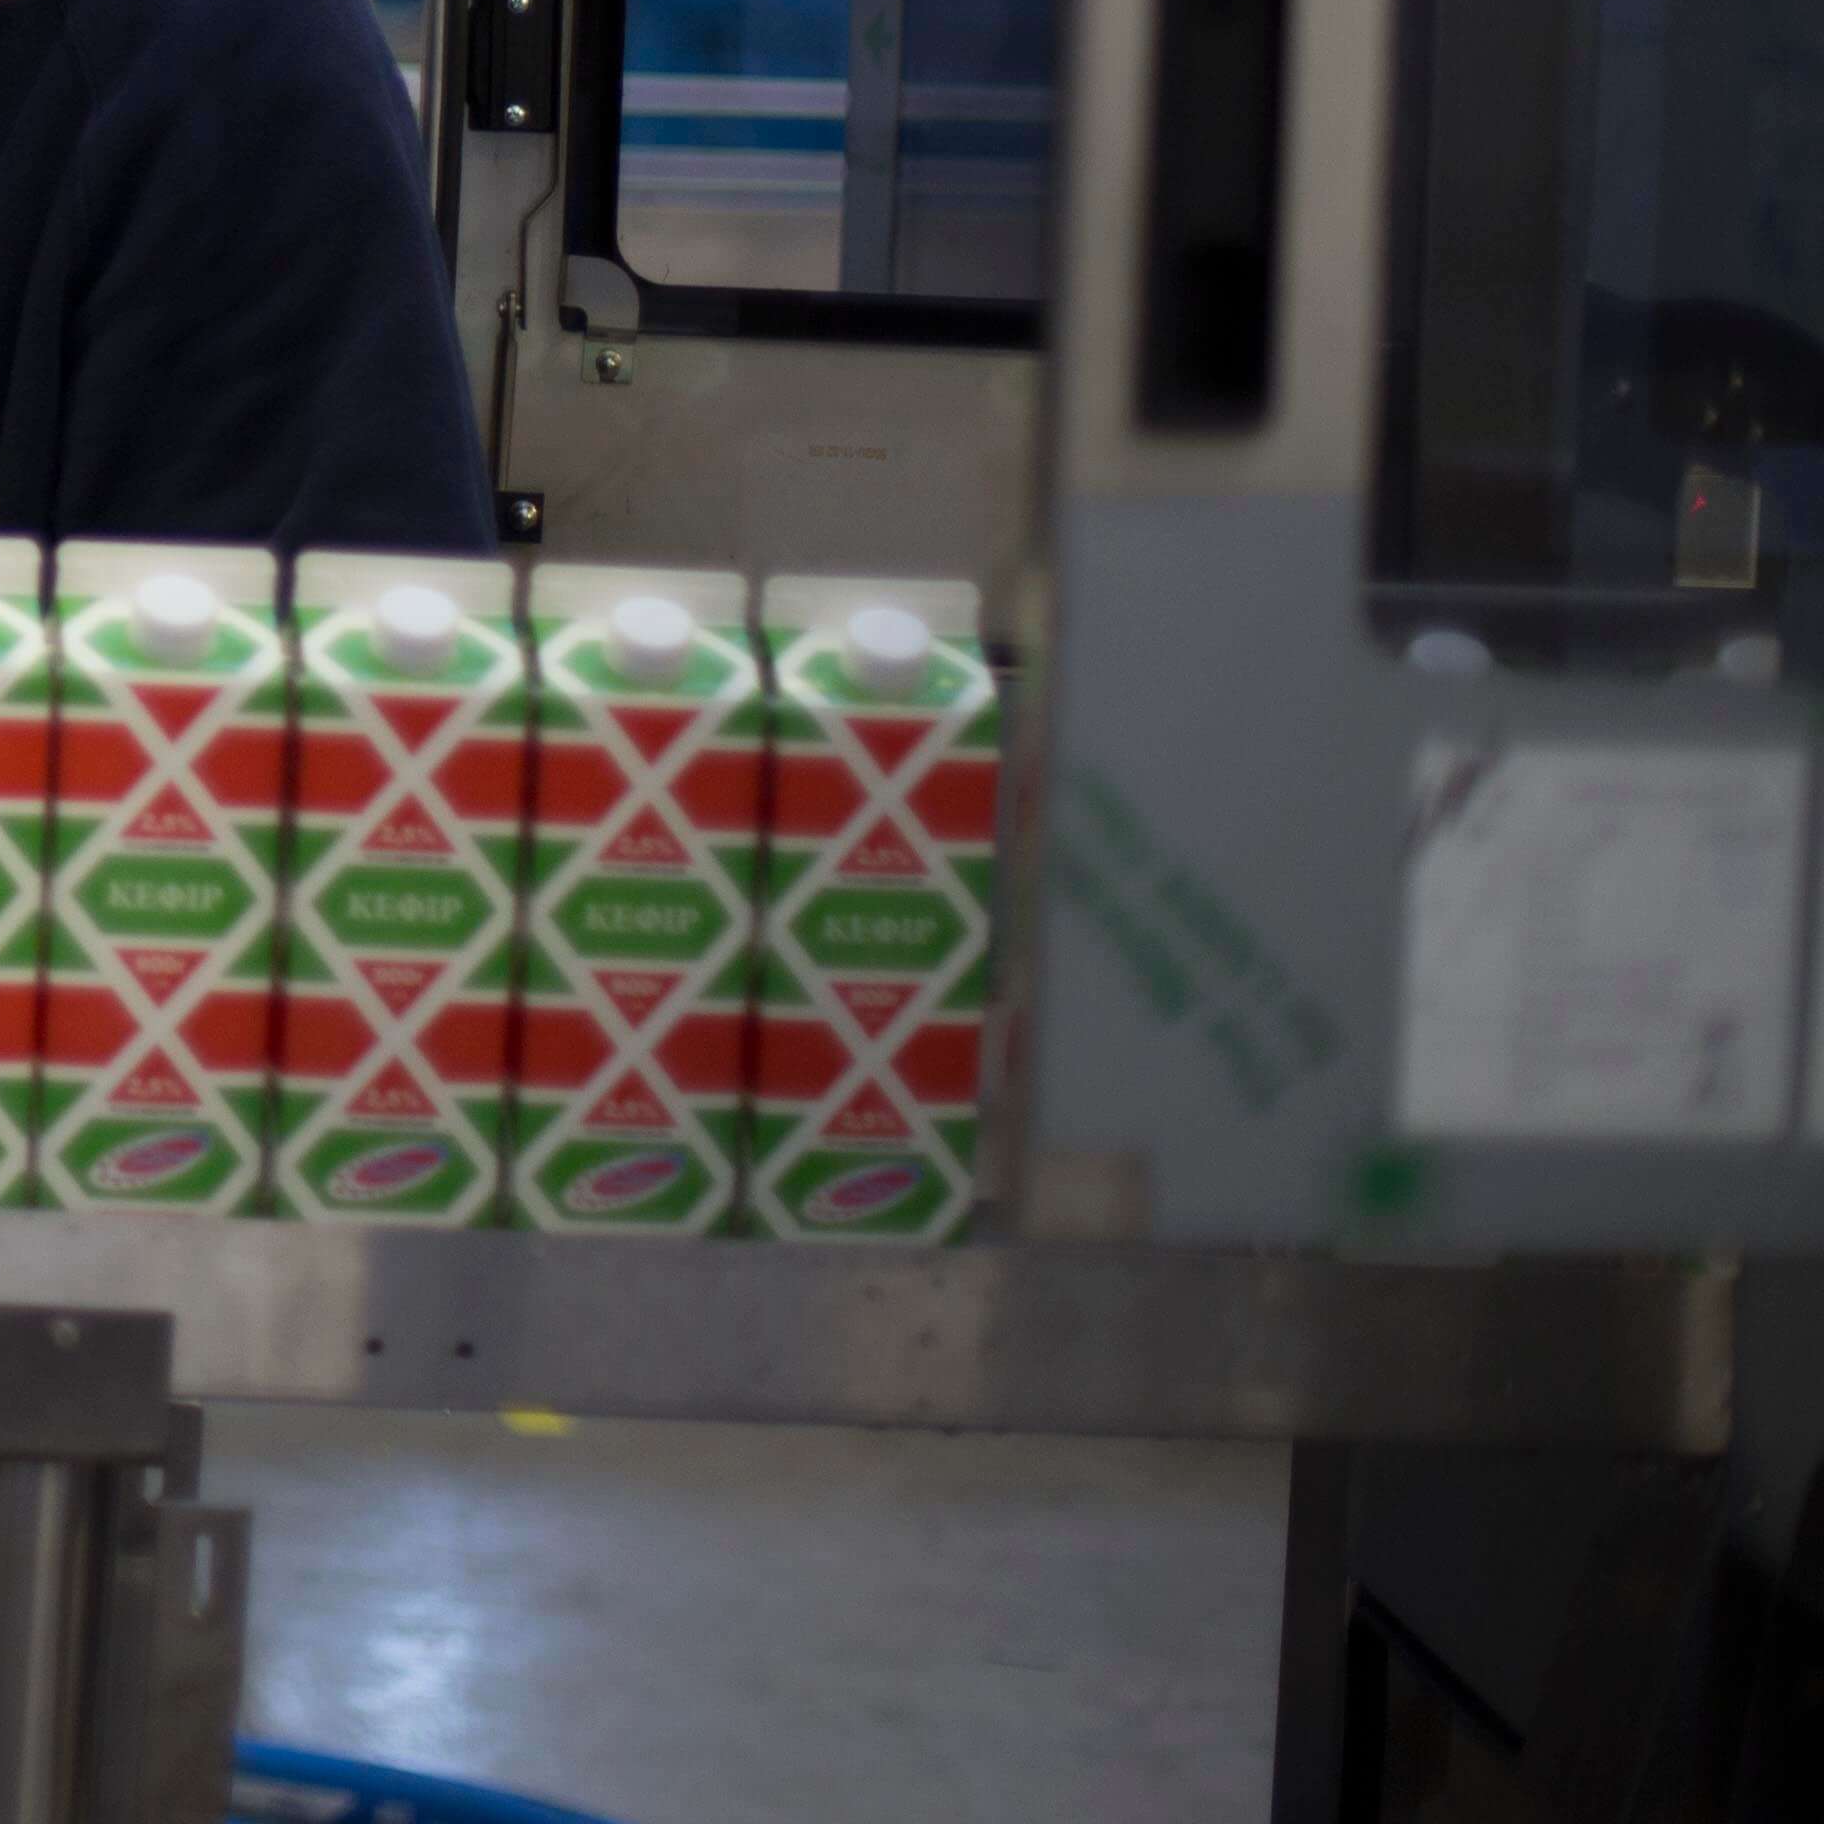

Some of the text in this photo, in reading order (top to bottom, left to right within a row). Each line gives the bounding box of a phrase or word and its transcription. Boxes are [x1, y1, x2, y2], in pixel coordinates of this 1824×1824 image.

[108, 882, 224, 911] КЕФІР
[348, 893, 464, 922] КЕФІР
[584, 904, 700, 933] КЕФІР
